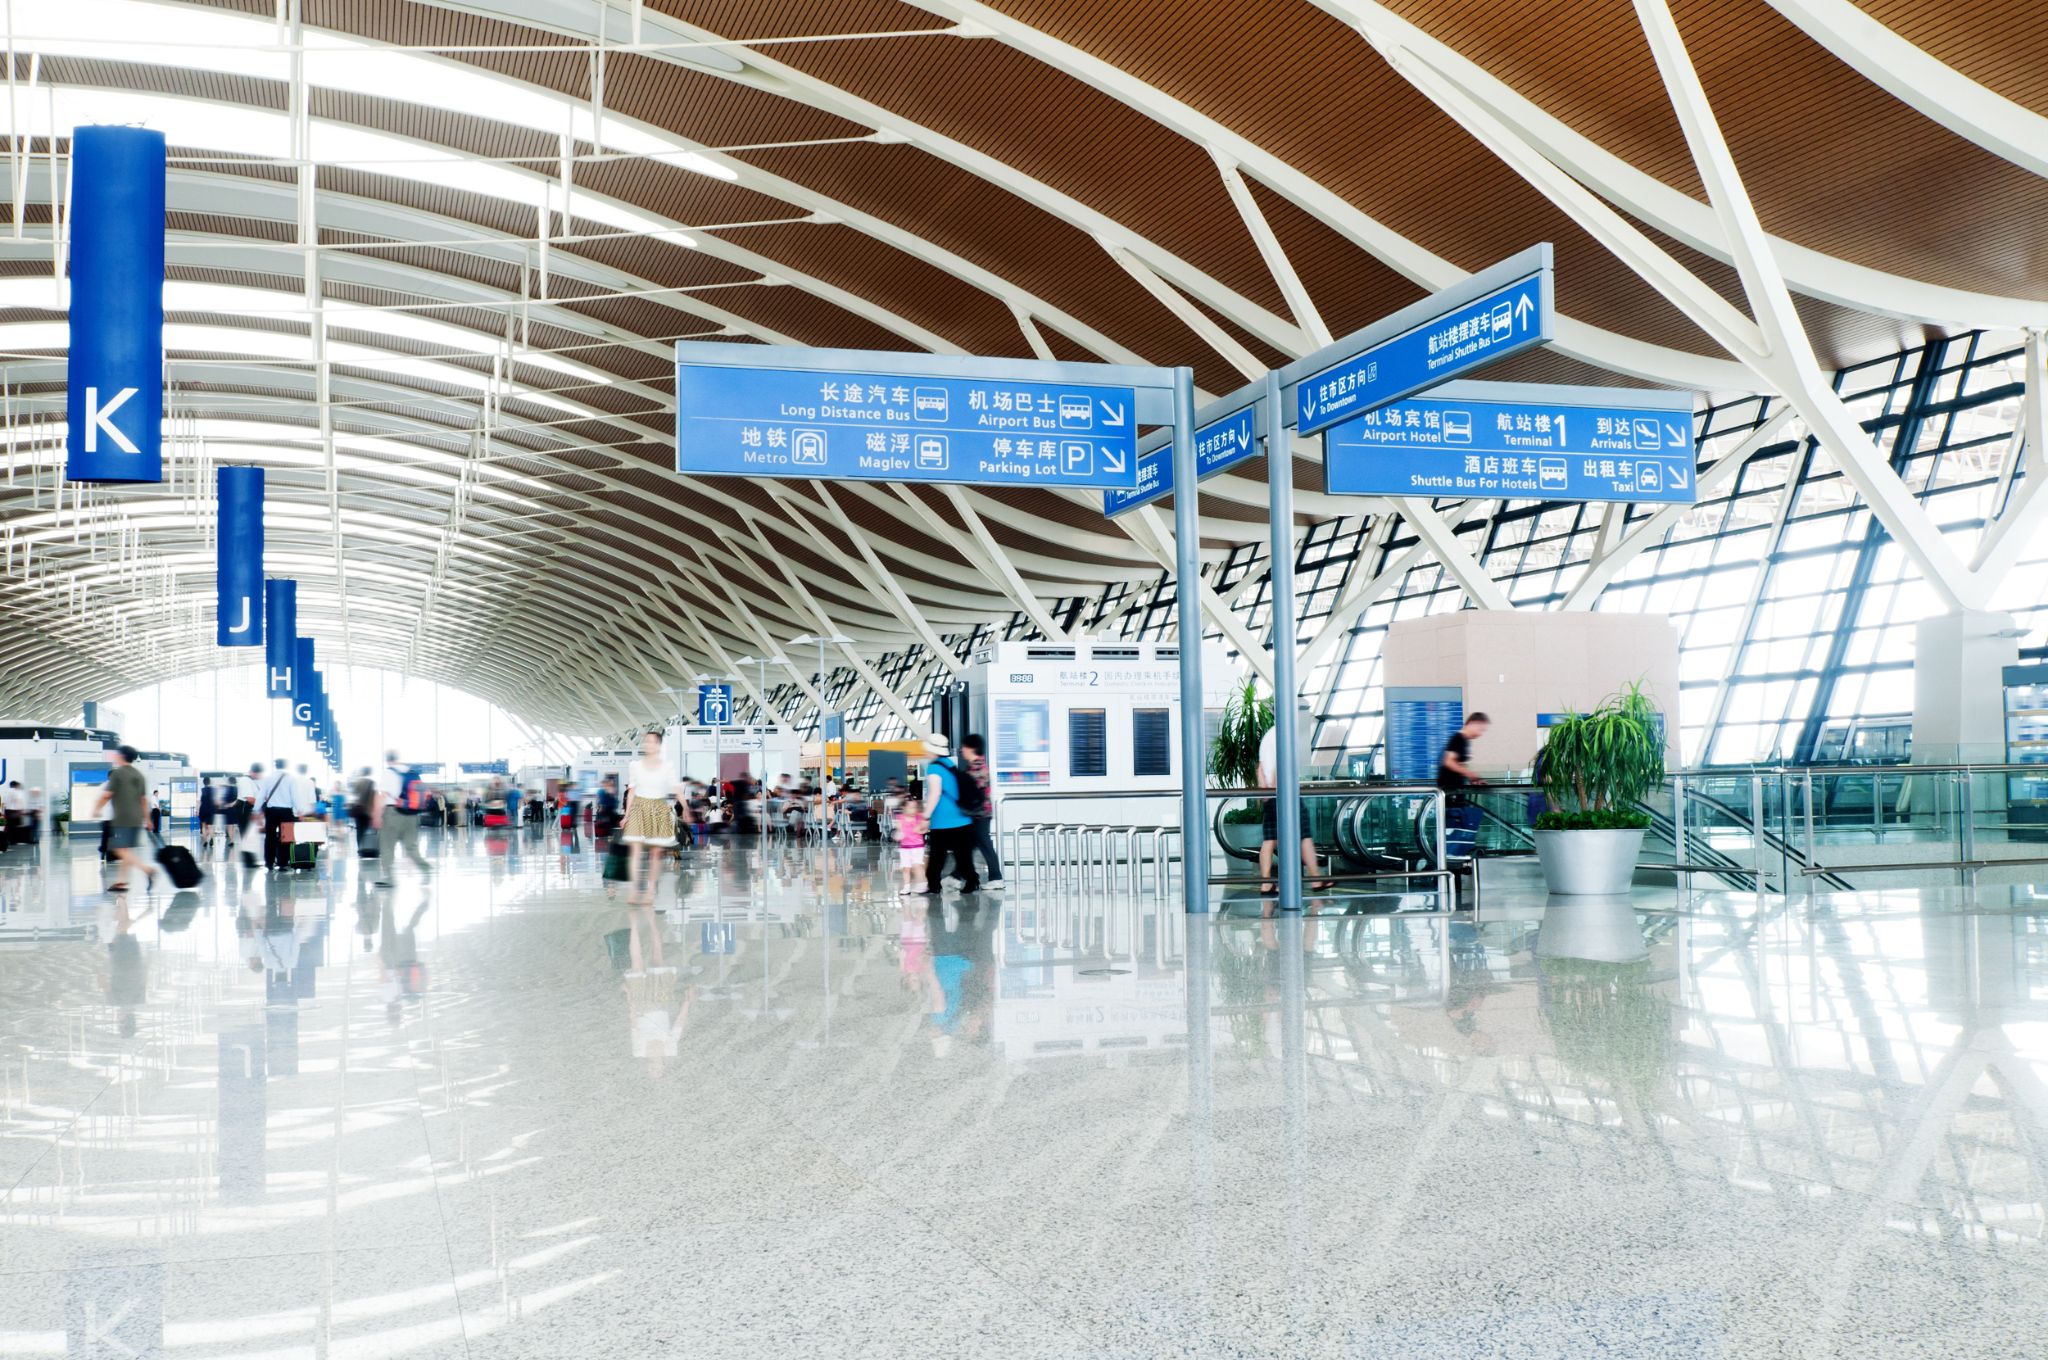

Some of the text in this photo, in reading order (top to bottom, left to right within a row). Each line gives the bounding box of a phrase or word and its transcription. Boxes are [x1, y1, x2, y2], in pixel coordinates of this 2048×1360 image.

[1428, 312, 1490, 355] 航站楼摆渡车
[1427, 337, 1491, 370] Terminal Shuttle Bus
[820, 382, 910, 405] 长途汽车
[1320, 369, 1366, 403] 往市区方向
[968, 390, 1055, 413] 机场巴士
[1320, 394, 1357, 415] To Downtown
[85, 387, 141, 453] K
[781, 404, 910, 421] Long Distance Bus
[978, 414, 1056, 429] Airport Bus
[1364, 408, 1440, 429] 机场宾馆
[1363, 429, 1441, 443] Airport Hotel
[1497, 412, 1567, 447] 航站楼 1
[1596, 417, 1631, 436] 到达
[741, 427, 787, 448] 地铁
[866, 433, 910, 453] 磁浮
[1198, 428, 1235, 458] 往市区方向
[1504, 434, 1552, 447] Terminal
[1590, 437, 1632, 449] Arrivals
[744, 451, 788, 464] Metro
[992, 438, 1056, 460] 停车库
[859, 456, 910, 471] Maglev
[980, 461, 1057, 477] Parking Lot
[1464, 455, 1537, 476] 酒店班车
[1583, 459, 1633, 479] 出租车
[1411, 474, 1537, 490] Shuttle Bus For Hotels
[1612, 481, 1634, 493] Taxi
[229, 597, 250, 632] J
[271, 667, 291, 691] H
[1089, 671, 1099, 686] 2
[295, 703, 312, 721] G
